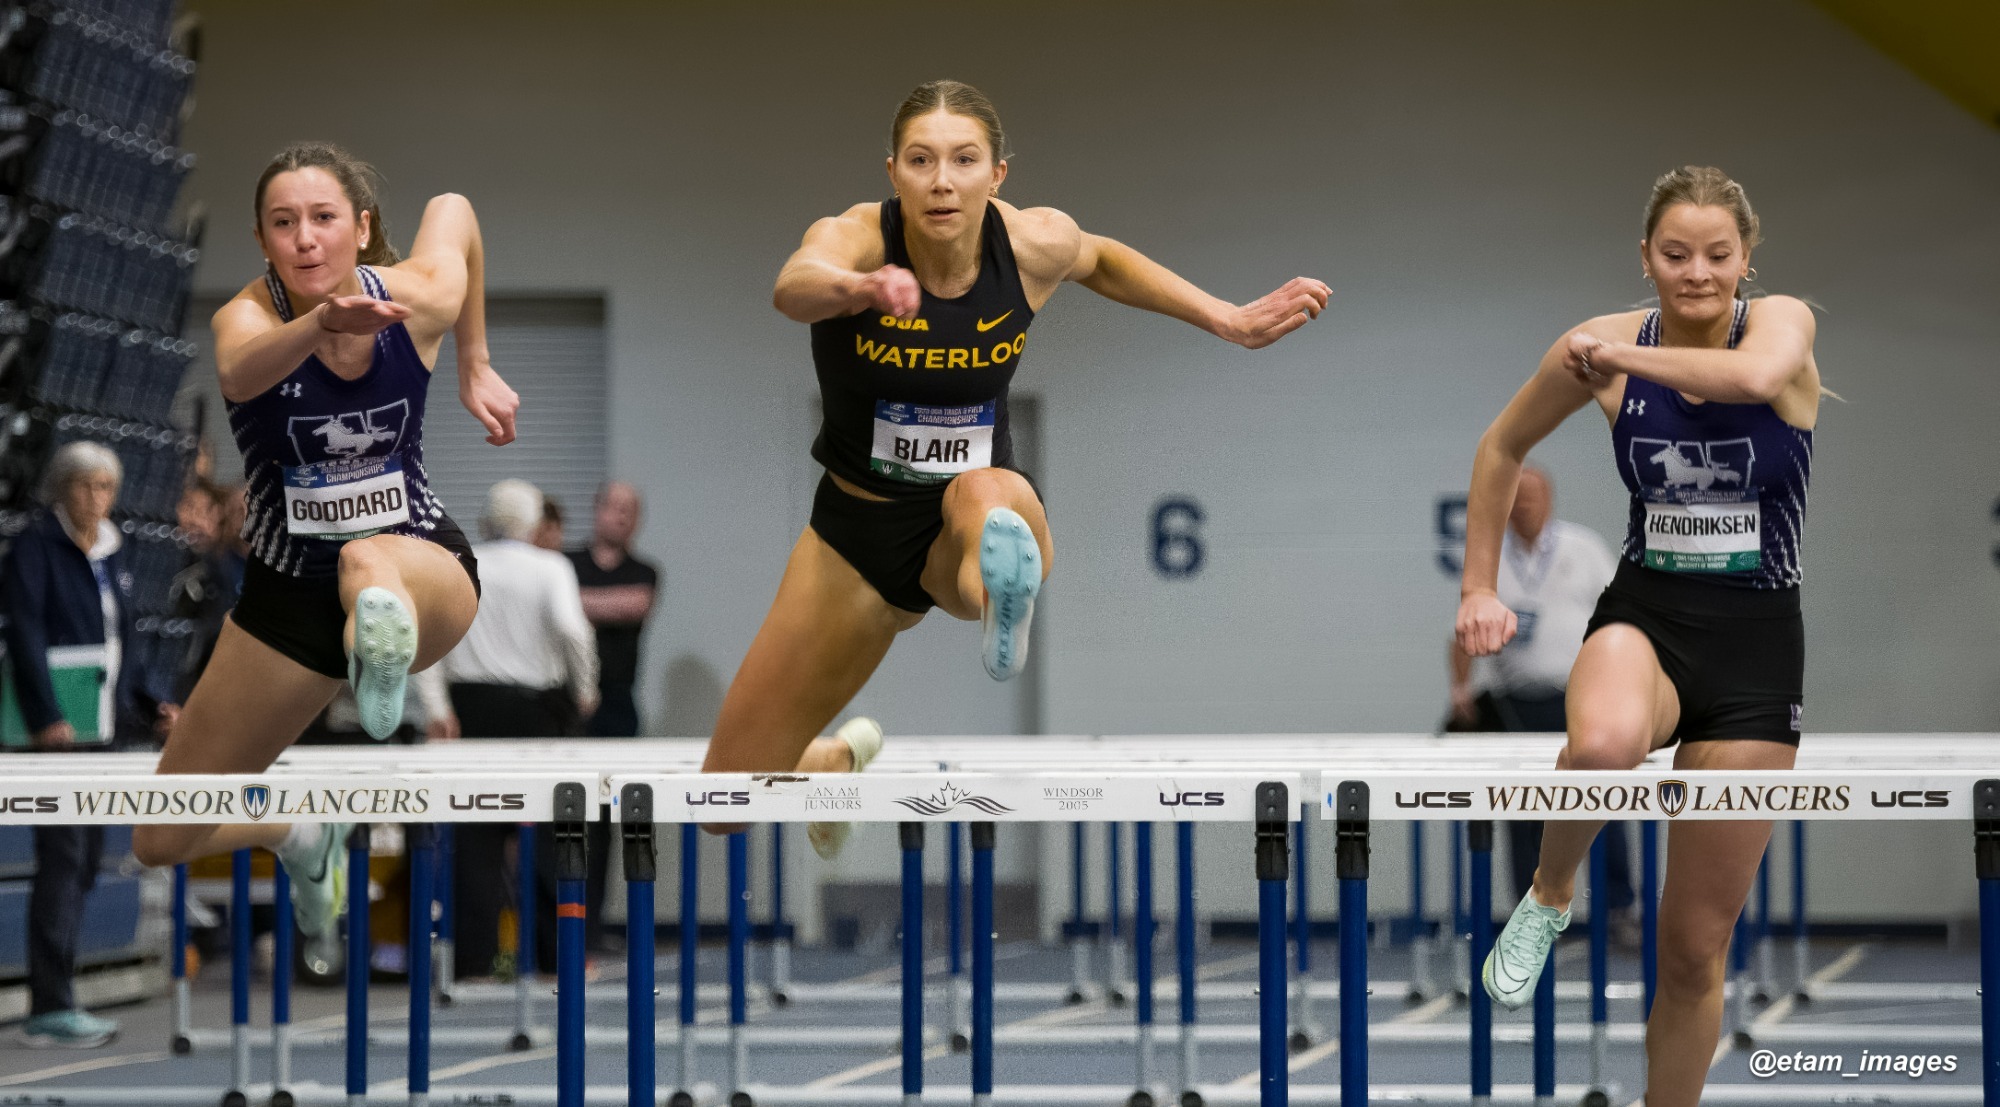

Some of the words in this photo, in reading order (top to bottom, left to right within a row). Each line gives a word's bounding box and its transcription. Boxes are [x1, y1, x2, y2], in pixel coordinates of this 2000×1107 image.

[879, 315, 930, 331] OUA
[856, 333, 1026, 369] WATERLOO
[917, 414, 978, 425] CHAMPIONSHIPS
[894, 436, 970, 463] BLAIR
[326, 462, 385, 483] CHAMPIONSHIPS
[292, 487, 403, 522] GODDARD
[1649, 514, 1756, 536] HENDRIKSEN
[1152, 498, 1204, 578] 6
[686, 791, 751, 806] UCS
[807, 787, 835, 797] AN
[838, 787, 860, 797] AM
[1043, 787, 1104, 798] WINDSOR
[1159, 792, 1225, 806] UCS
[1395, 791, 1472, 808] UCS
[1486, 786, 1651, 811] WINDSOR
[1691, 785, 1850, 811] LANCERS
[1871, 791, 1949, 808] UCS
[73, 790, 235, 816] WINDSOR
[275, 788, 430, 814] LANCERS
[449, 793, 525, 811] UCS
[804, 800, 862, 812] JUNIORS
[1058, 801, 1089, 811] 2005
